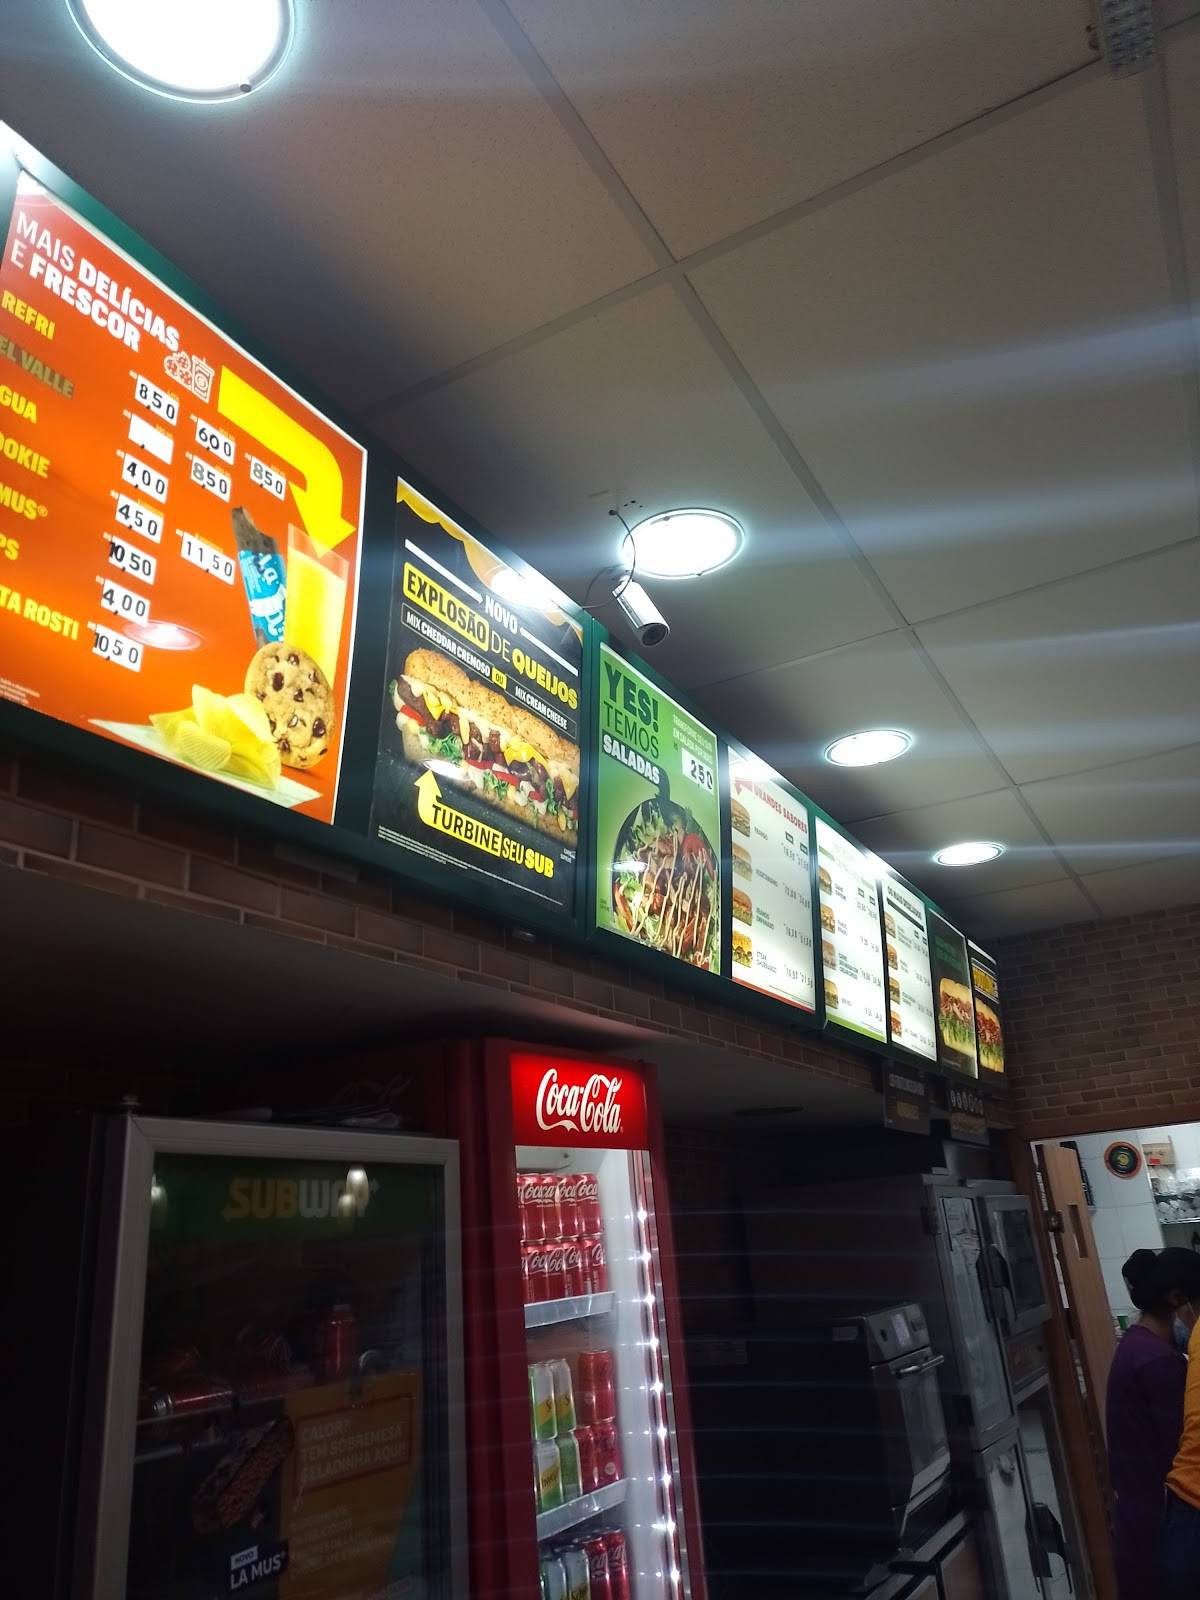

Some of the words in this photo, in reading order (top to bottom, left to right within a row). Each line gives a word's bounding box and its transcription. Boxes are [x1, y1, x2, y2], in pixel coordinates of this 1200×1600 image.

[11, 239, 28, 270] E
[29, 252, 141, 352] FRESCOR
[17, 211, 75, 272] MAIS
[79, 257, 180, 351] DELÍCIAS
[2, 290, 56, 340] REFRI
[22, 350, 75, 400] VALLE
[24, 598, 79, 641] ROSTI
[407, 570, 486, 643] EXPLOSÃO
[491, 631, 511, 662] DE
[512, 648, 578, 709] QUEIJOS
[485, 594, 518, 634] NOVO
[406, 612, 421, 632] MIX
[420, 620, 456, 654] CHEDDAR
[456, 646, 490, 677] CREMOSO
[515, 686, 527, 702] MIX
[526, 694, 547, 715] CREAM
[546, 706, 568, 729] CHEESE
[604, 661, 659, 733] YES!
[603, 700, 659, 759] TEMOS
[603, 734, 660, 785] SALADAS
[432, 804, 501, 857] TURBINE
[502, 838, 524, 864] SEU
[524, 848, 554, 878] SUB
[536, 1068, 622, 1133] Coca-Cola
[231, 1567, 248, 1590] LA
